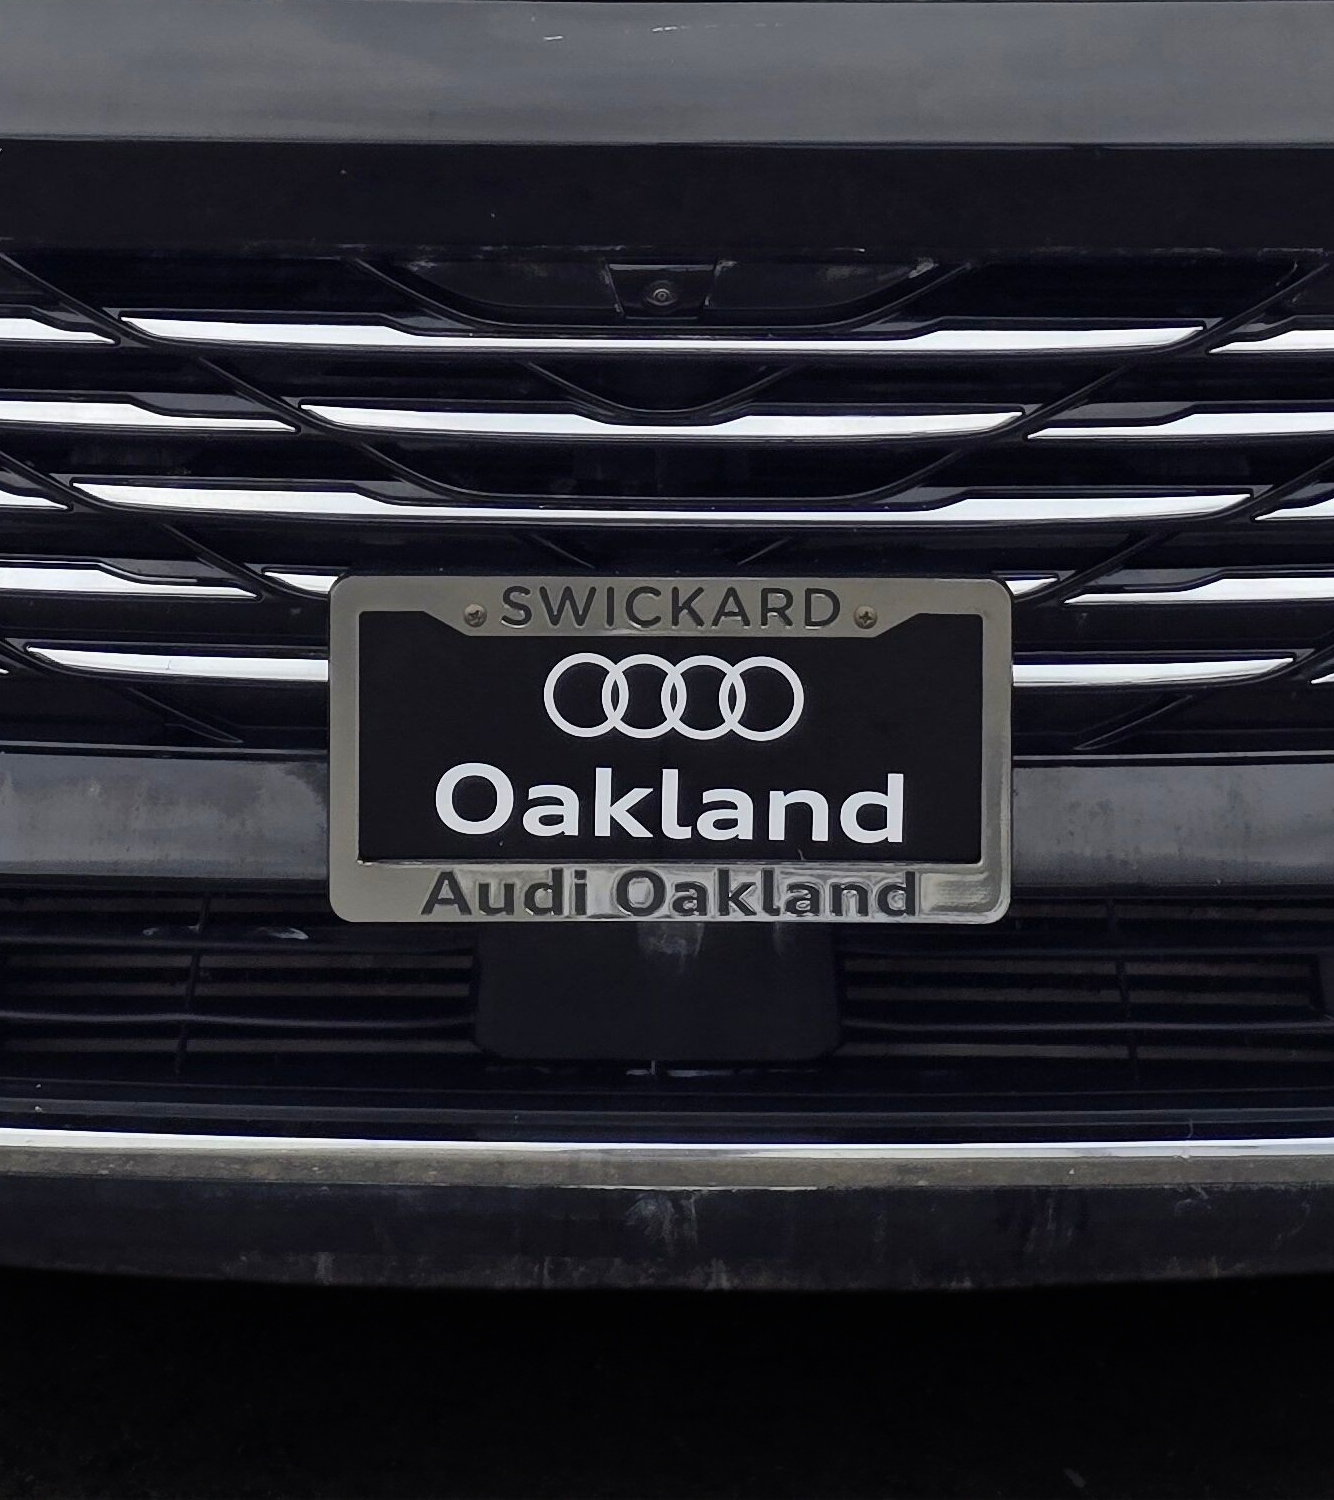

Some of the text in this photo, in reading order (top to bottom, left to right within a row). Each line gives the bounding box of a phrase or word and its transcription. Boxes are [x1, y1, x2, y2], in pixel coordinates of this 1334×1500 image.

[501, 586, 842, 629] SWICKARD
[435, 762, 904, 844] Oakland
[420, 869, 917, 918] Audi Oakland
